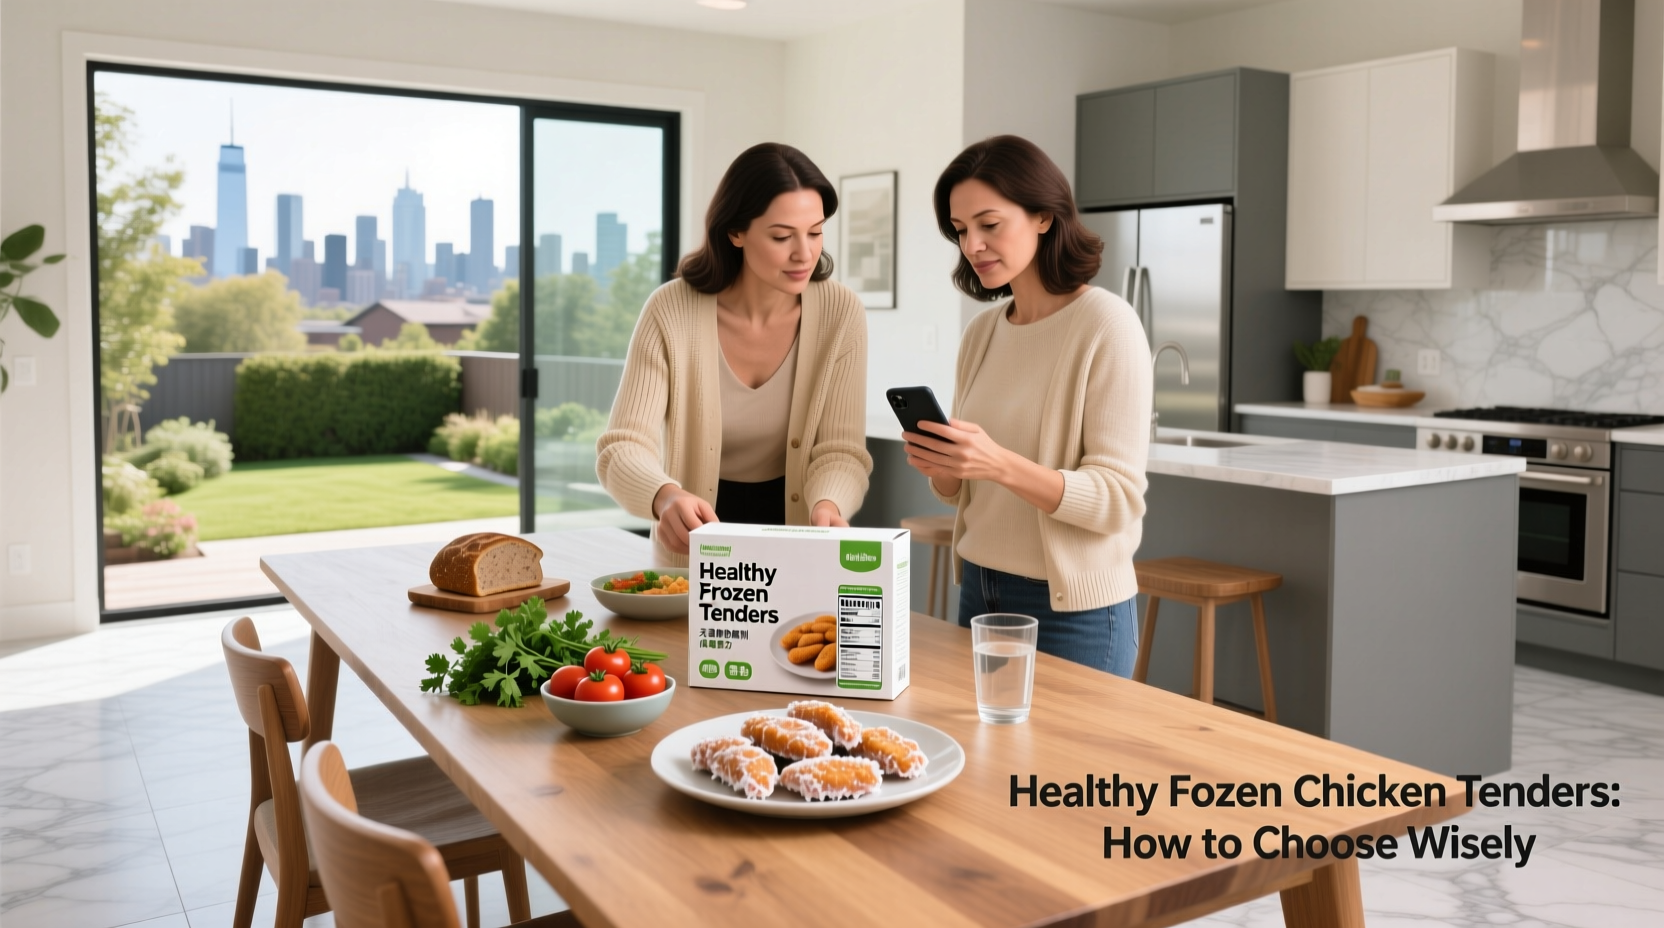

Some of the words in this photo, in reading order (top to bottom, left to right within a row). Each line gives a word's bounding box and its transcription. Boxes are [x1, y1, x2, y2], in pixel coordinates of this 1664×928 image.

[699, 562, 777, 587] Healthy
[699, 582, 769, 603] Frozen
[698, 603, 780, 624] Tenders
